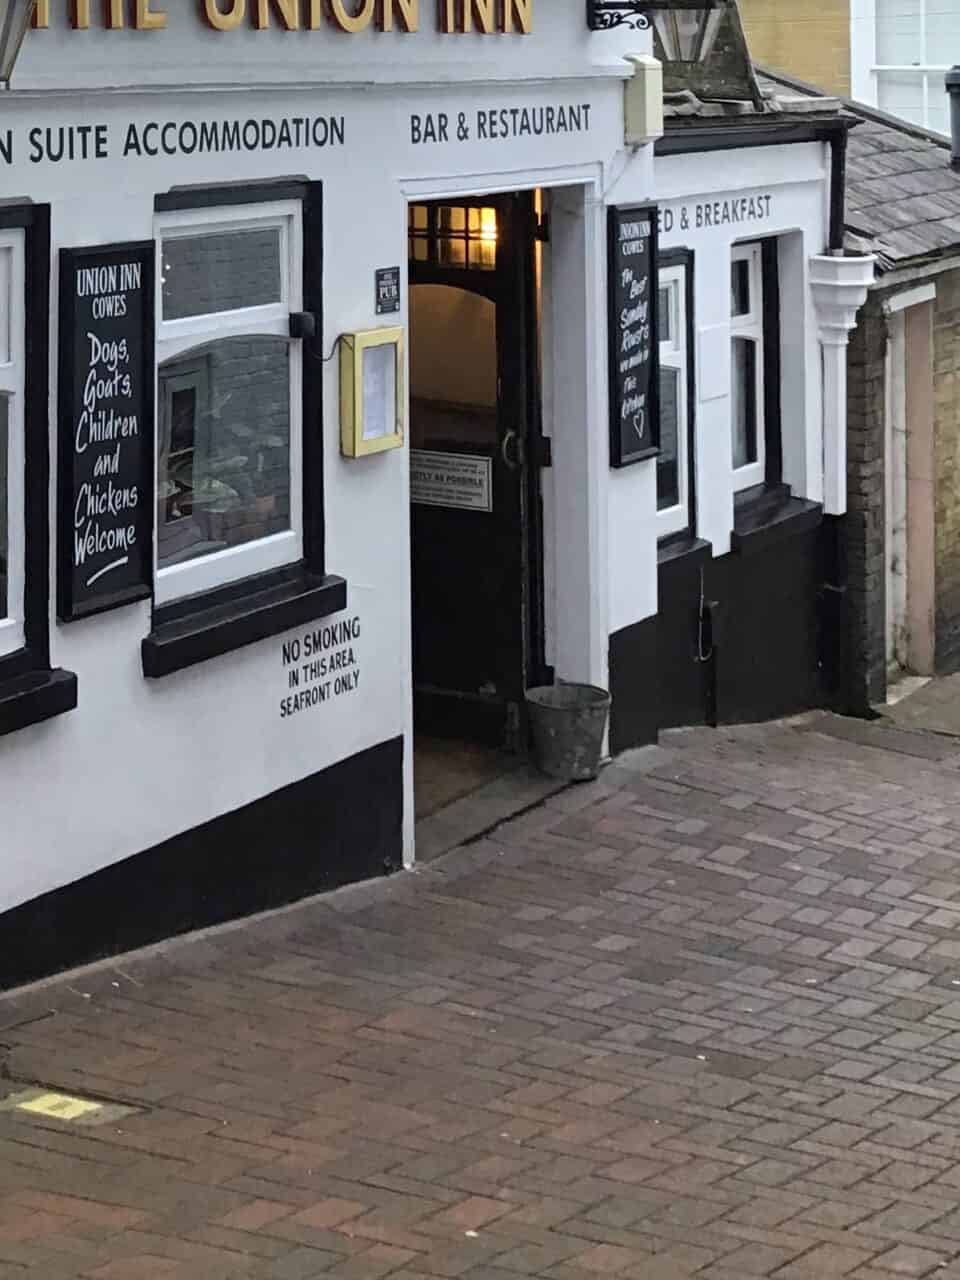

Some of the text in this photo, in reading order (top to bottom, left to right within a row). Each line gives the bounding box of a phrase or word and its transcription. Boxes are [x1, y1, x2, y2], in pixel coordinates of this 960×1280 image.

[29, 125, 108, 163] SUITE
[123, 116, 345, 156] ACCOMMODATION
[411, 103, 591, 144] BAR & RESTAURANT
[657, 195, 771, 233] ED & BREAKFAST
[76, 262, 142, 296] UNION INN
[92, 294, 127, 319] COWES
[87, 332, 130, 371] Dogs,
[84, 368, 132, 413] Goats,
[75, 408, 138, 453] Children
[94, 443, 121, 477] and
[74, 480, 138, 529] Chickens
[74, 520, 136, 566] Welcome
[282, 616, 360, 666] NO SMOKING
[280, 669, 360, 718] SEAFRONT ONLY
[288, 668, 299, 688] IN
[302, 658, 327, 682] THIS
